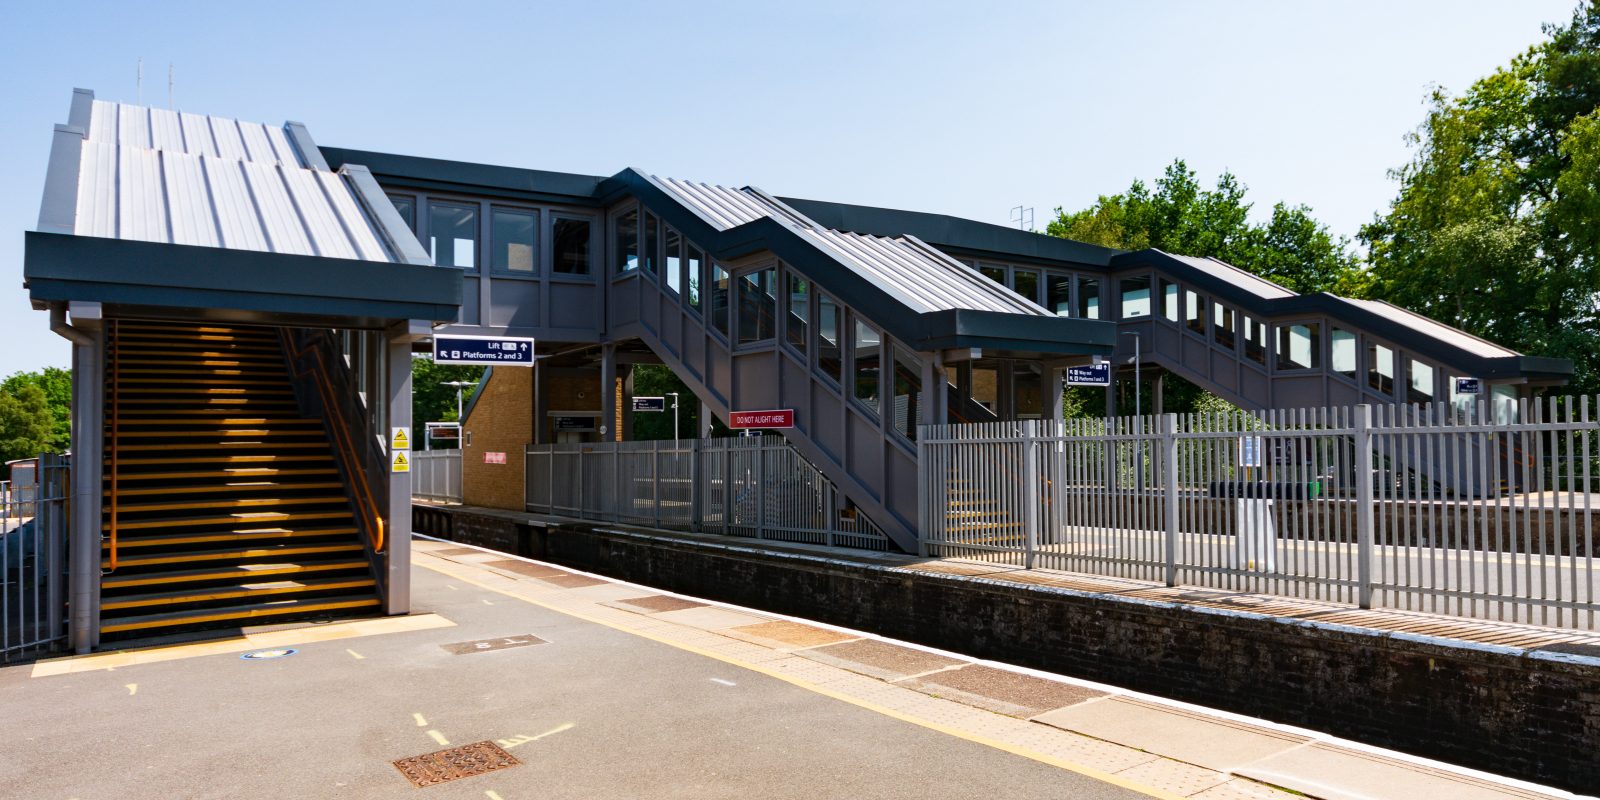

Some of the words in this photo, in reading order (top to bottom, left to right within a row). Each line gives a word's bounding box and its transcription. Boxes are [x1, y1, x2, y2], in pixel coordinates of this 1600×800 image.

[463, 351, 496, 359] Platforms
[755, 415, 771, 423] ALIGHT
[772, 415, 784, 423] HERE
